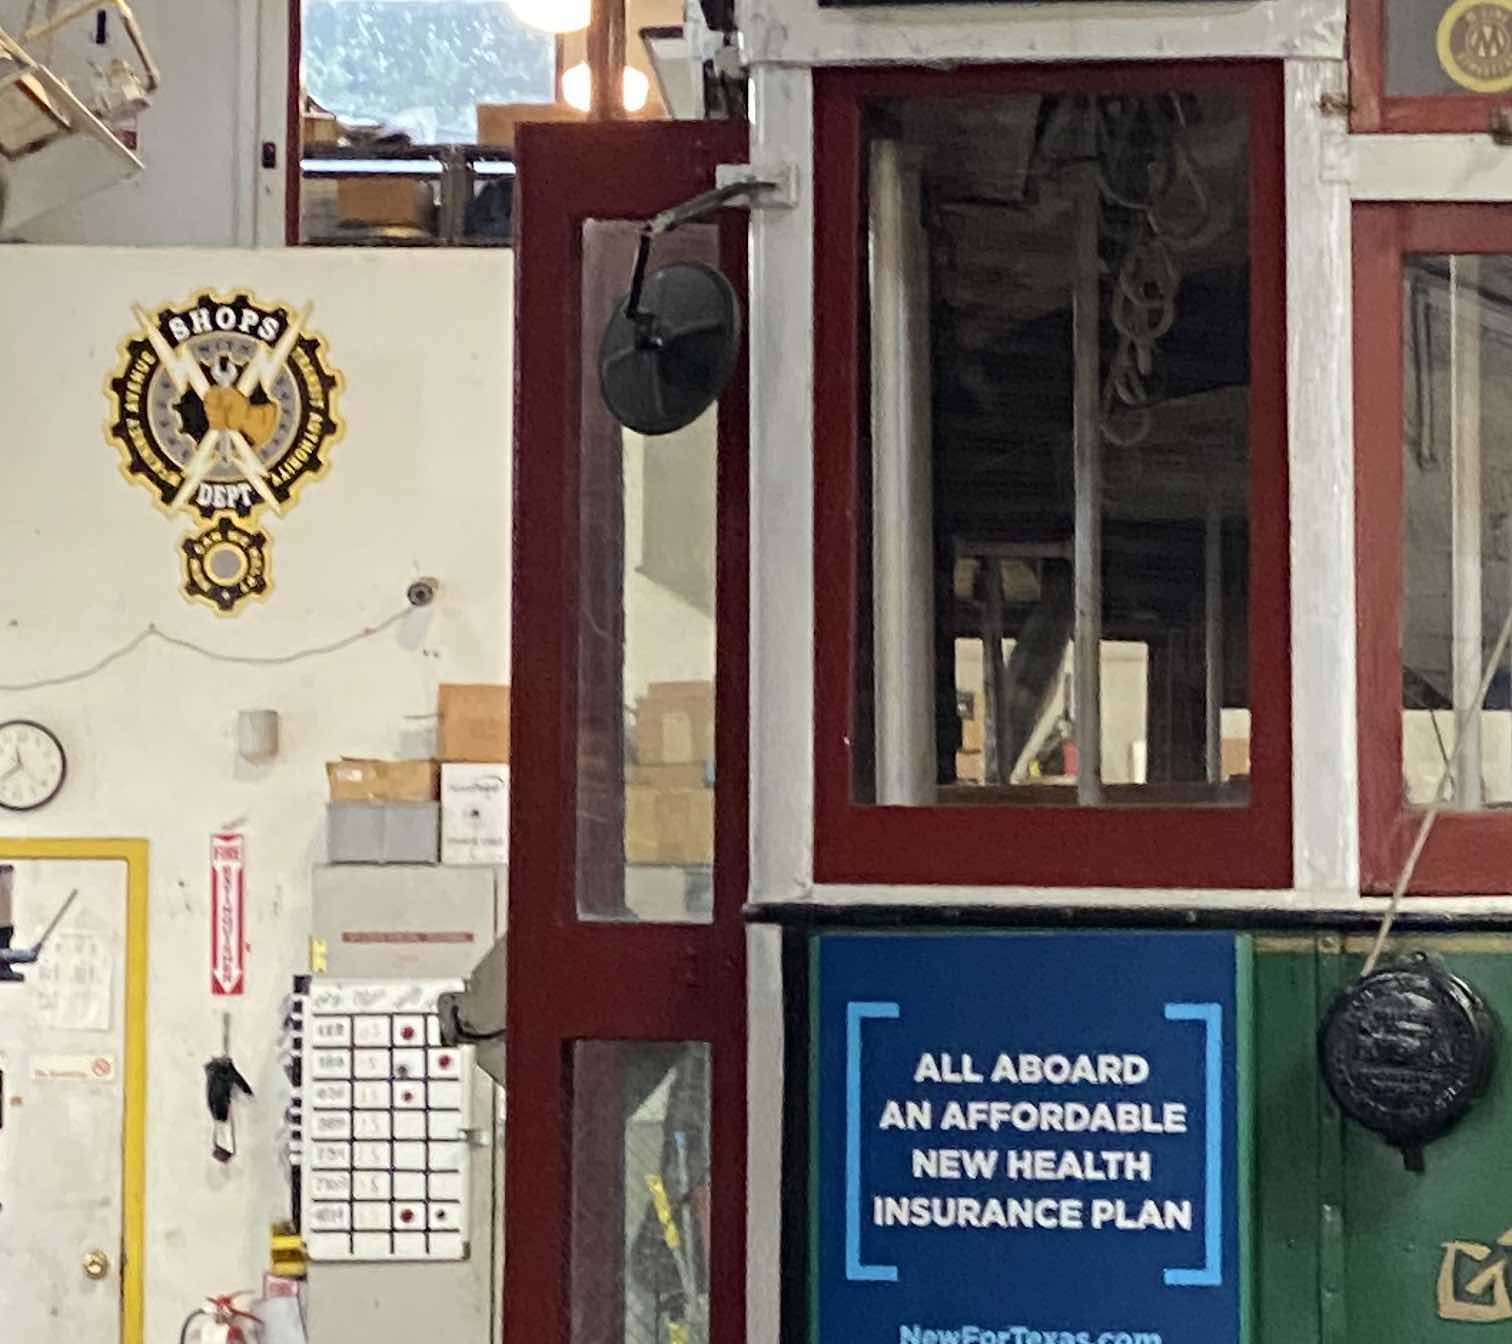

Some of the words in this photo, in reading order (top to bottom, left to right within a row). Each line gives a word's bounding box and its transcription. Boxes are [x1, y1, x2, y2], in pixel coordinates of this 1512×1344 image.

[167, 306, 281, 343] SHOPS
[197, 481, 256, 508] DEPT
[914, 1053, 984, 1084] ALL
[991, 1054, 1150, 1085] ABOARD
[879, 1100, 932, 1131] AN
[940, 1101, 1188, 1134] AFFORDABLE
[912, 1148, 999, 1179] NEW
[1007, 1150, 1153, 1182] HEALTH
[873, 1195, 1084, 1229] INSURANCE
[1091, 1199, 1192, 1232] PLAN
